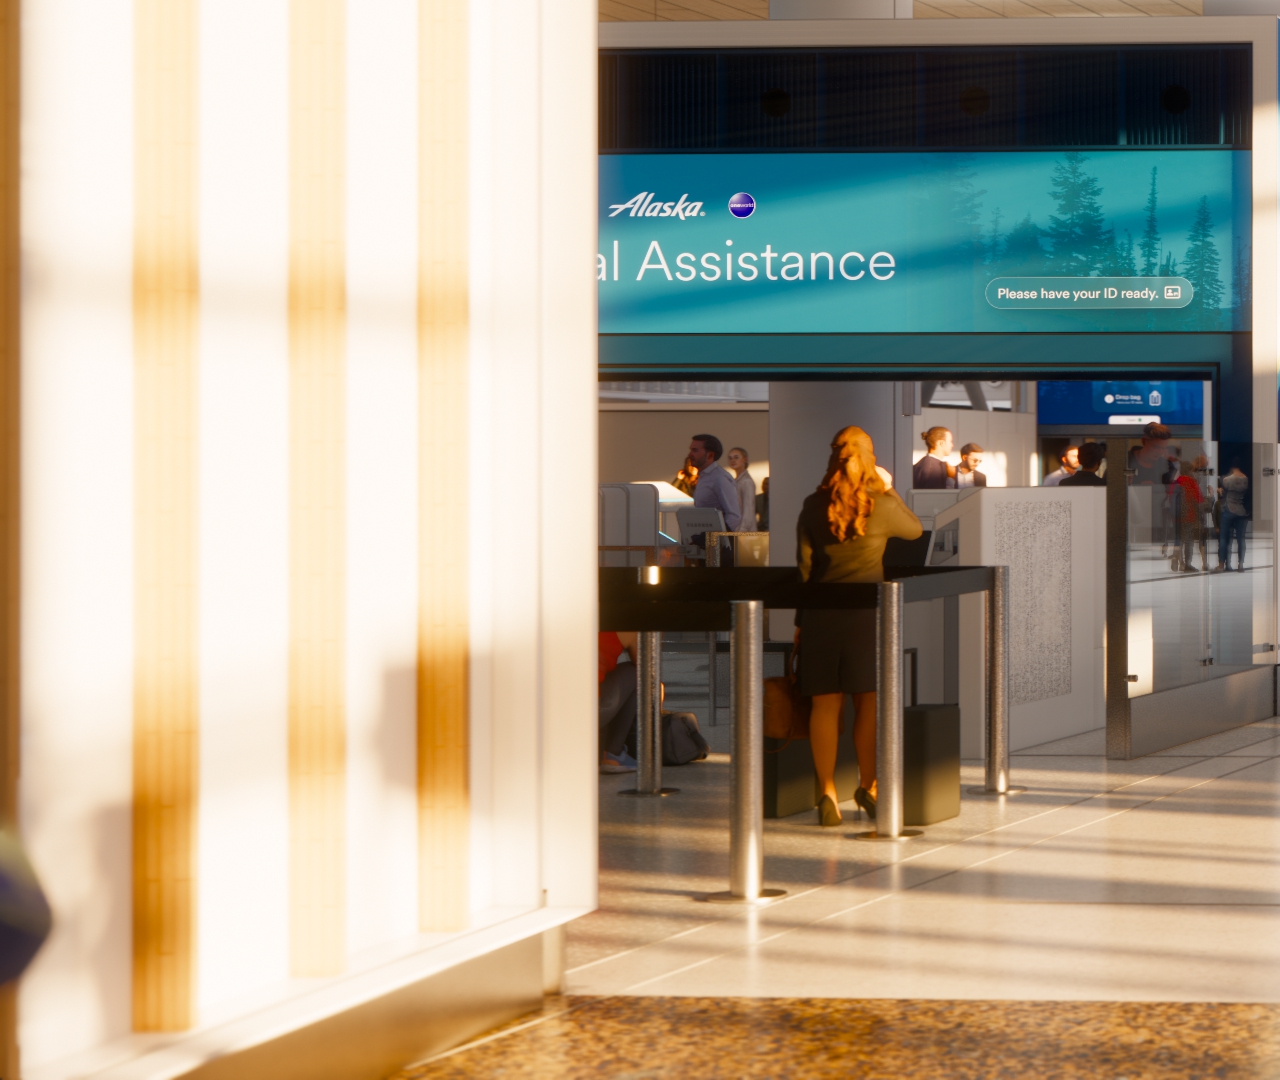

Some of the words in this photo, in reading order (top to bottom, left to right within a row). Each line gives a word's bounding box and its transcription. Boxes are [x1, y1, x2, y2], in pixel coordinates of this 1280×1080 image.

[636, 239, 896, 282] Assistance
[997, 287, 1038, 299] Please
[1040, 287, 1070, 299] have
[1073, 290, 1101, 302] your
[1104, 287, 1118, 299] ID
[1121, 287, 1159, 302] ready.
